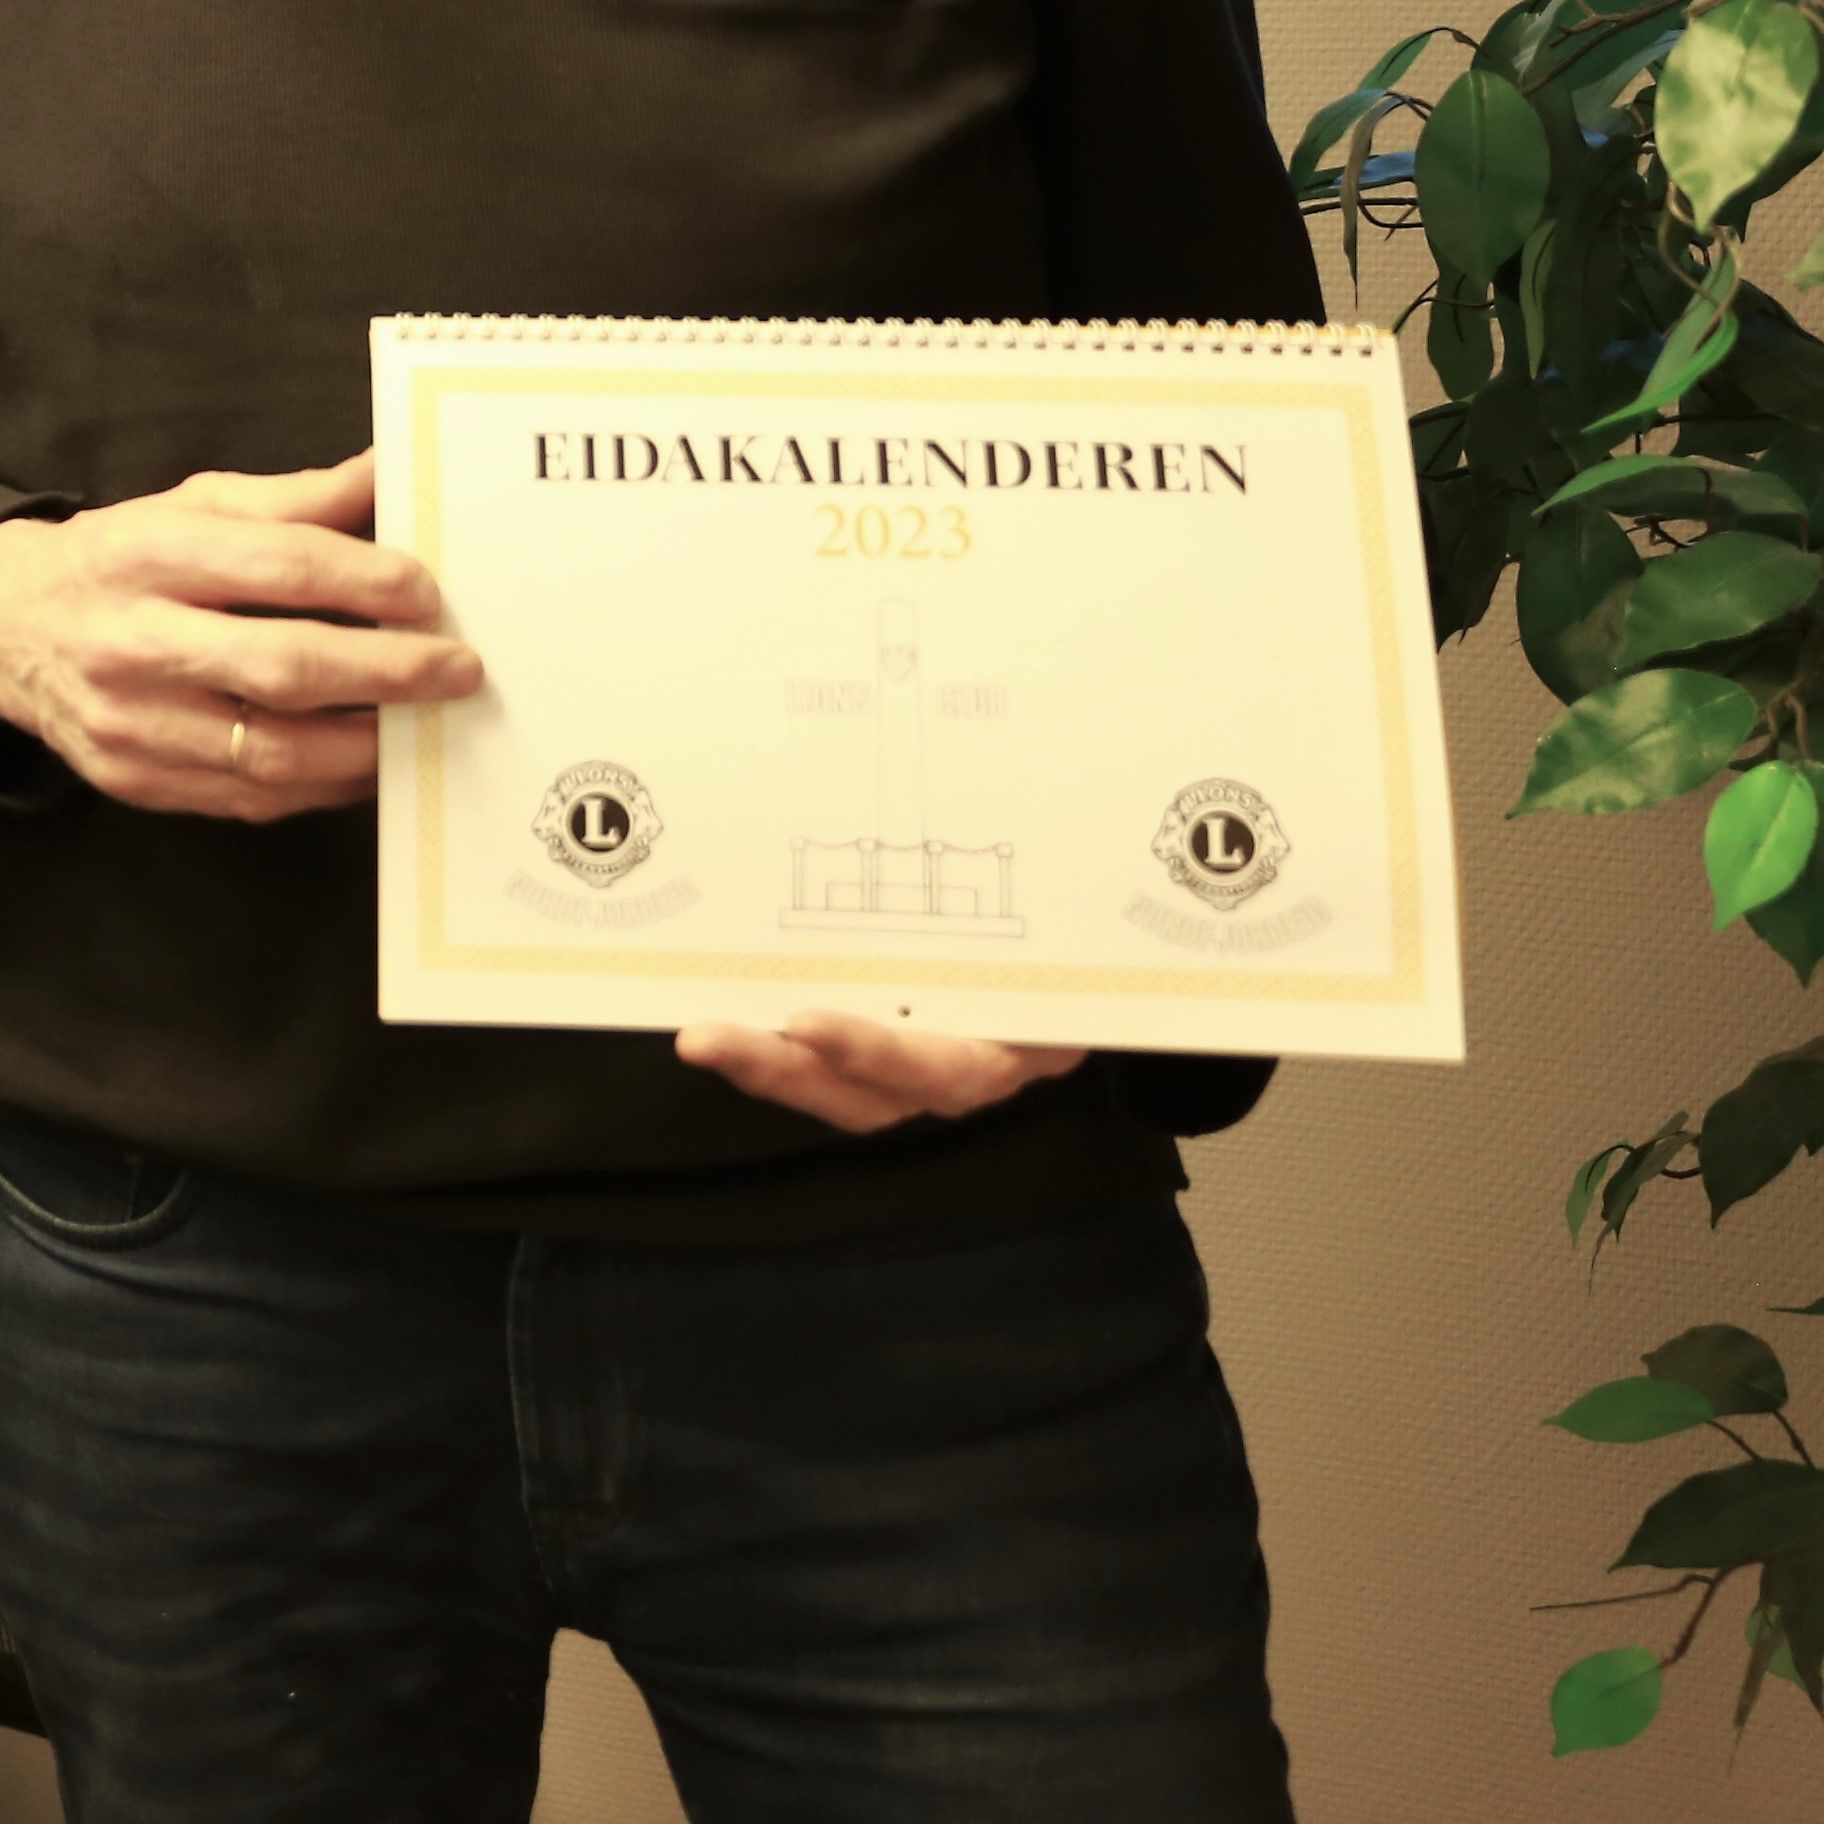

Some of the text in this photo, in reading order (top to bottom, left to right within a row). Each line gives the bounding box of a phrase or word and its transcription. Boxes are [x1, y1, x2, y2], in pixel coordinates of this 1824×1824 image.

[531, 432, 1249, 496] EIDAKALENDEREN
[814, 502, 974, 560] 2023
[581, 798, 619, 847] L
[1178, 786, 1260, 812] LIONS
[1204, 818, 1244, 866] L
